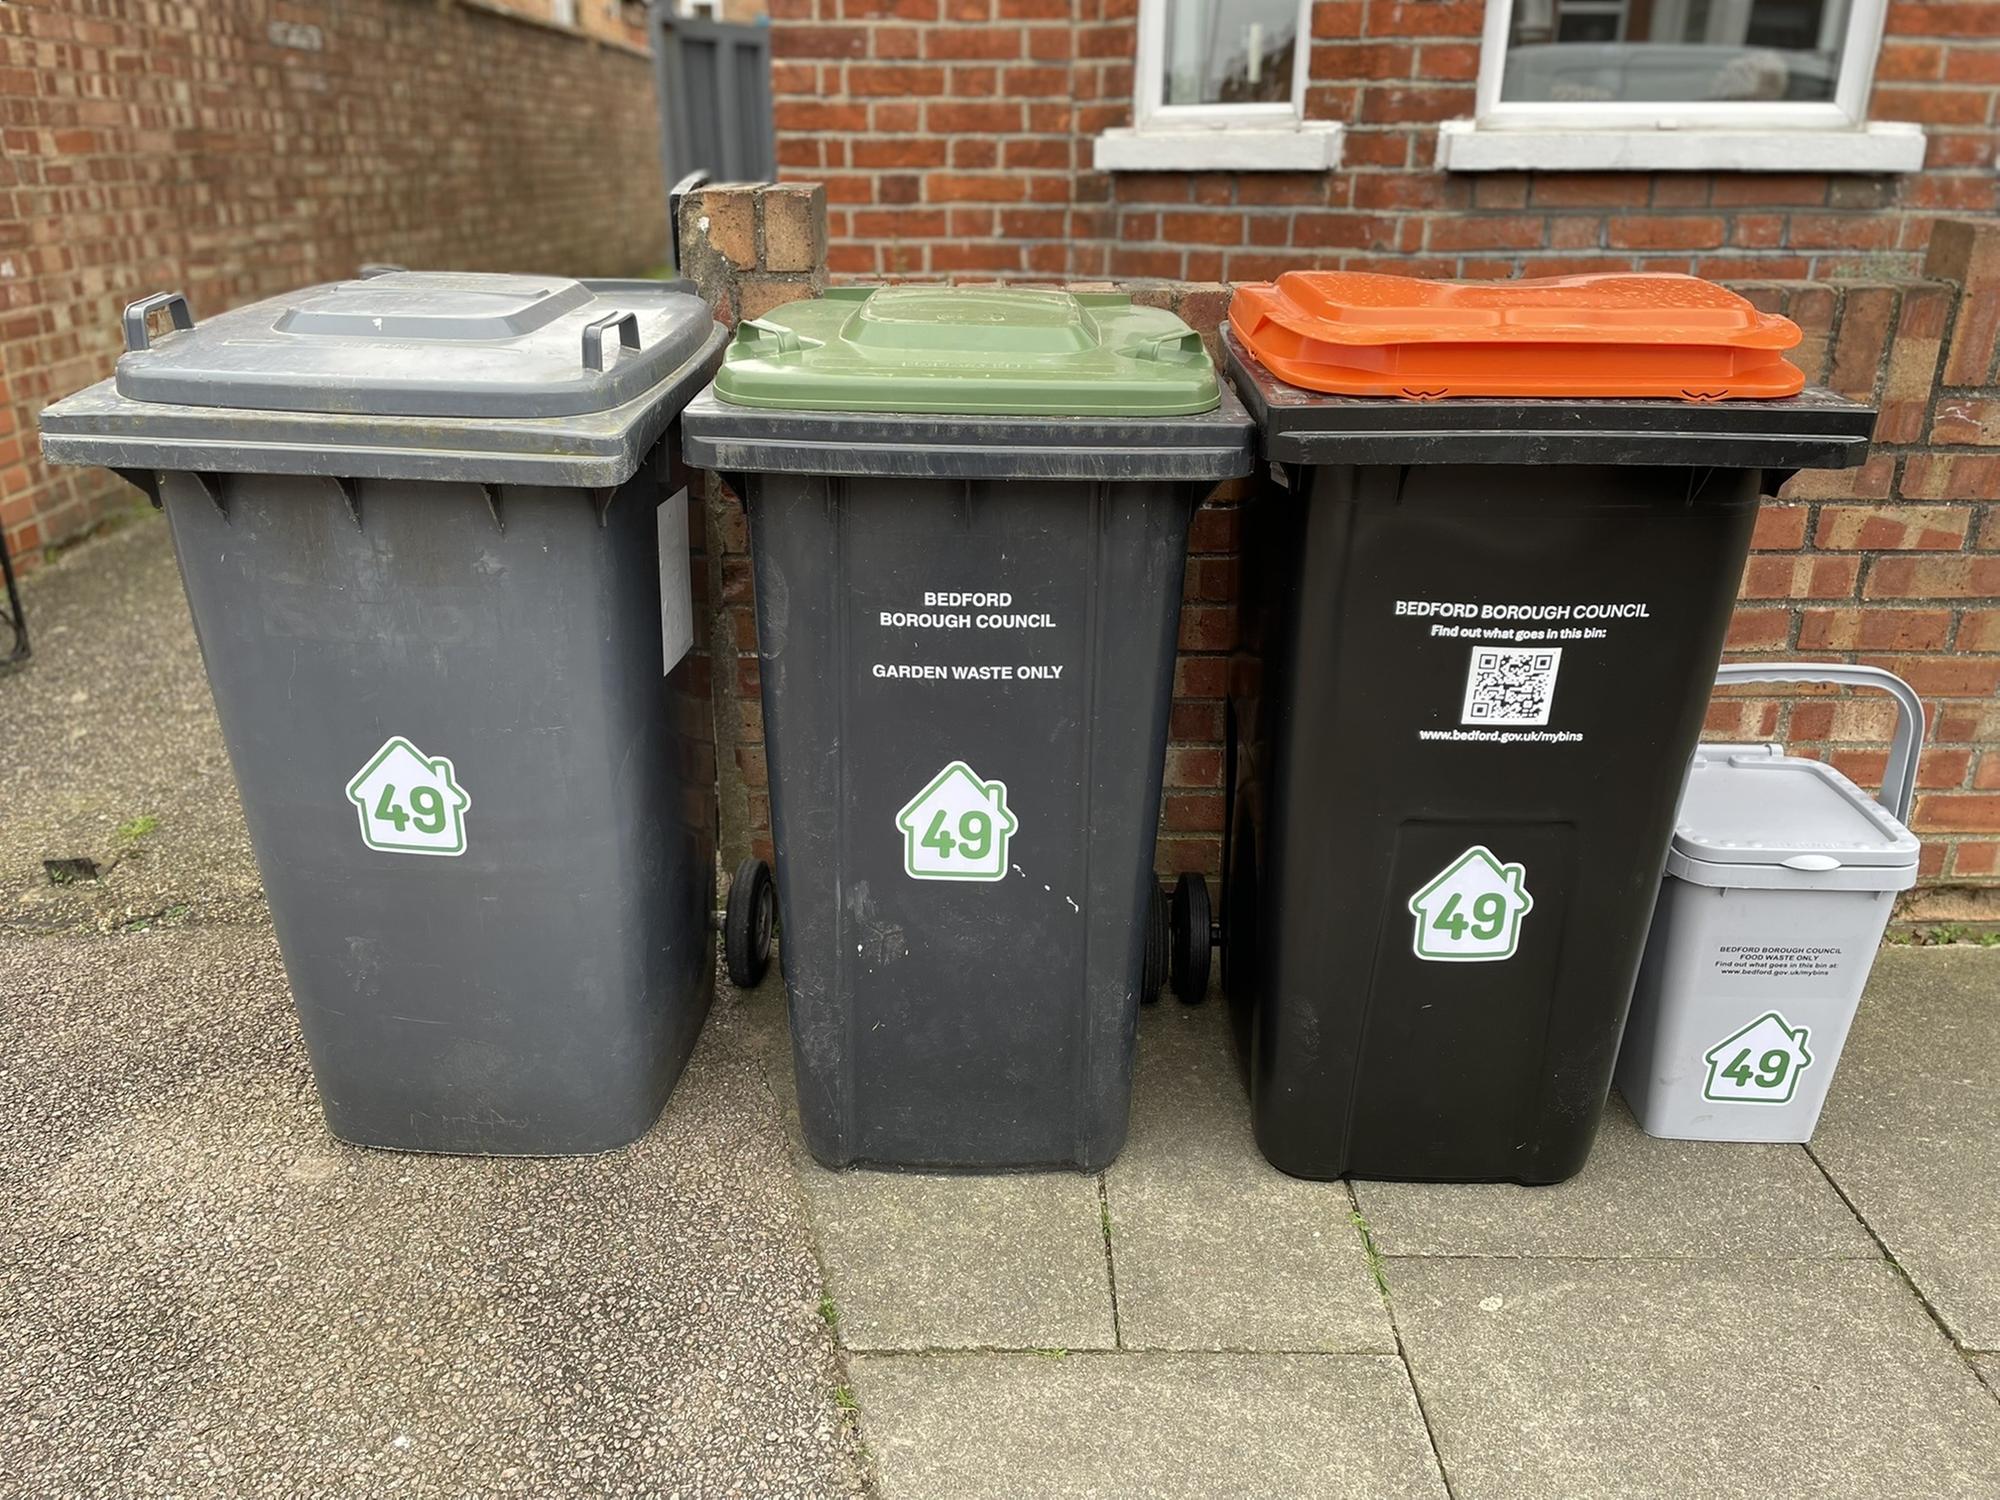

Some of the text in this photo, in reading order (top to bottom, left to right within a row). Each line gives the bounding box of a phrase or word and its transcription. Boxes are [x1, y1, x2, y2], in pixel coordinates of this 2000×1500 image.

[924, 591, 1013, 608] BEDFORD
[1395, 600, 1650, 620] BEDFORD BOROUGH COUNCIL
[879, 611, 1057, 629] BOROUGH COUNCIL
[1431, 624, 1607, 642] Find out what goes in this bin:
[872, 663, 1064, 680] GARDEN WASTE ONLY
[1419, 729, 1583, 743] www.bedford.gov.uk/mybins
[375, 785, 446, 834] 49
[921, 810, 993, 861] 49
[1433, 893, 1507, 941] 49
[1765, 954, 1795, 962] WASTE
[1806, 947, 1843, 955] COUNCIL
[1721, 969, 1829, 977] www.bedford.gov.uk/mybins
[1734, 961, 1748, 969] out
[1749, 961, 1768, 969] what
[1721, 1049, 1791, 1088] 49
